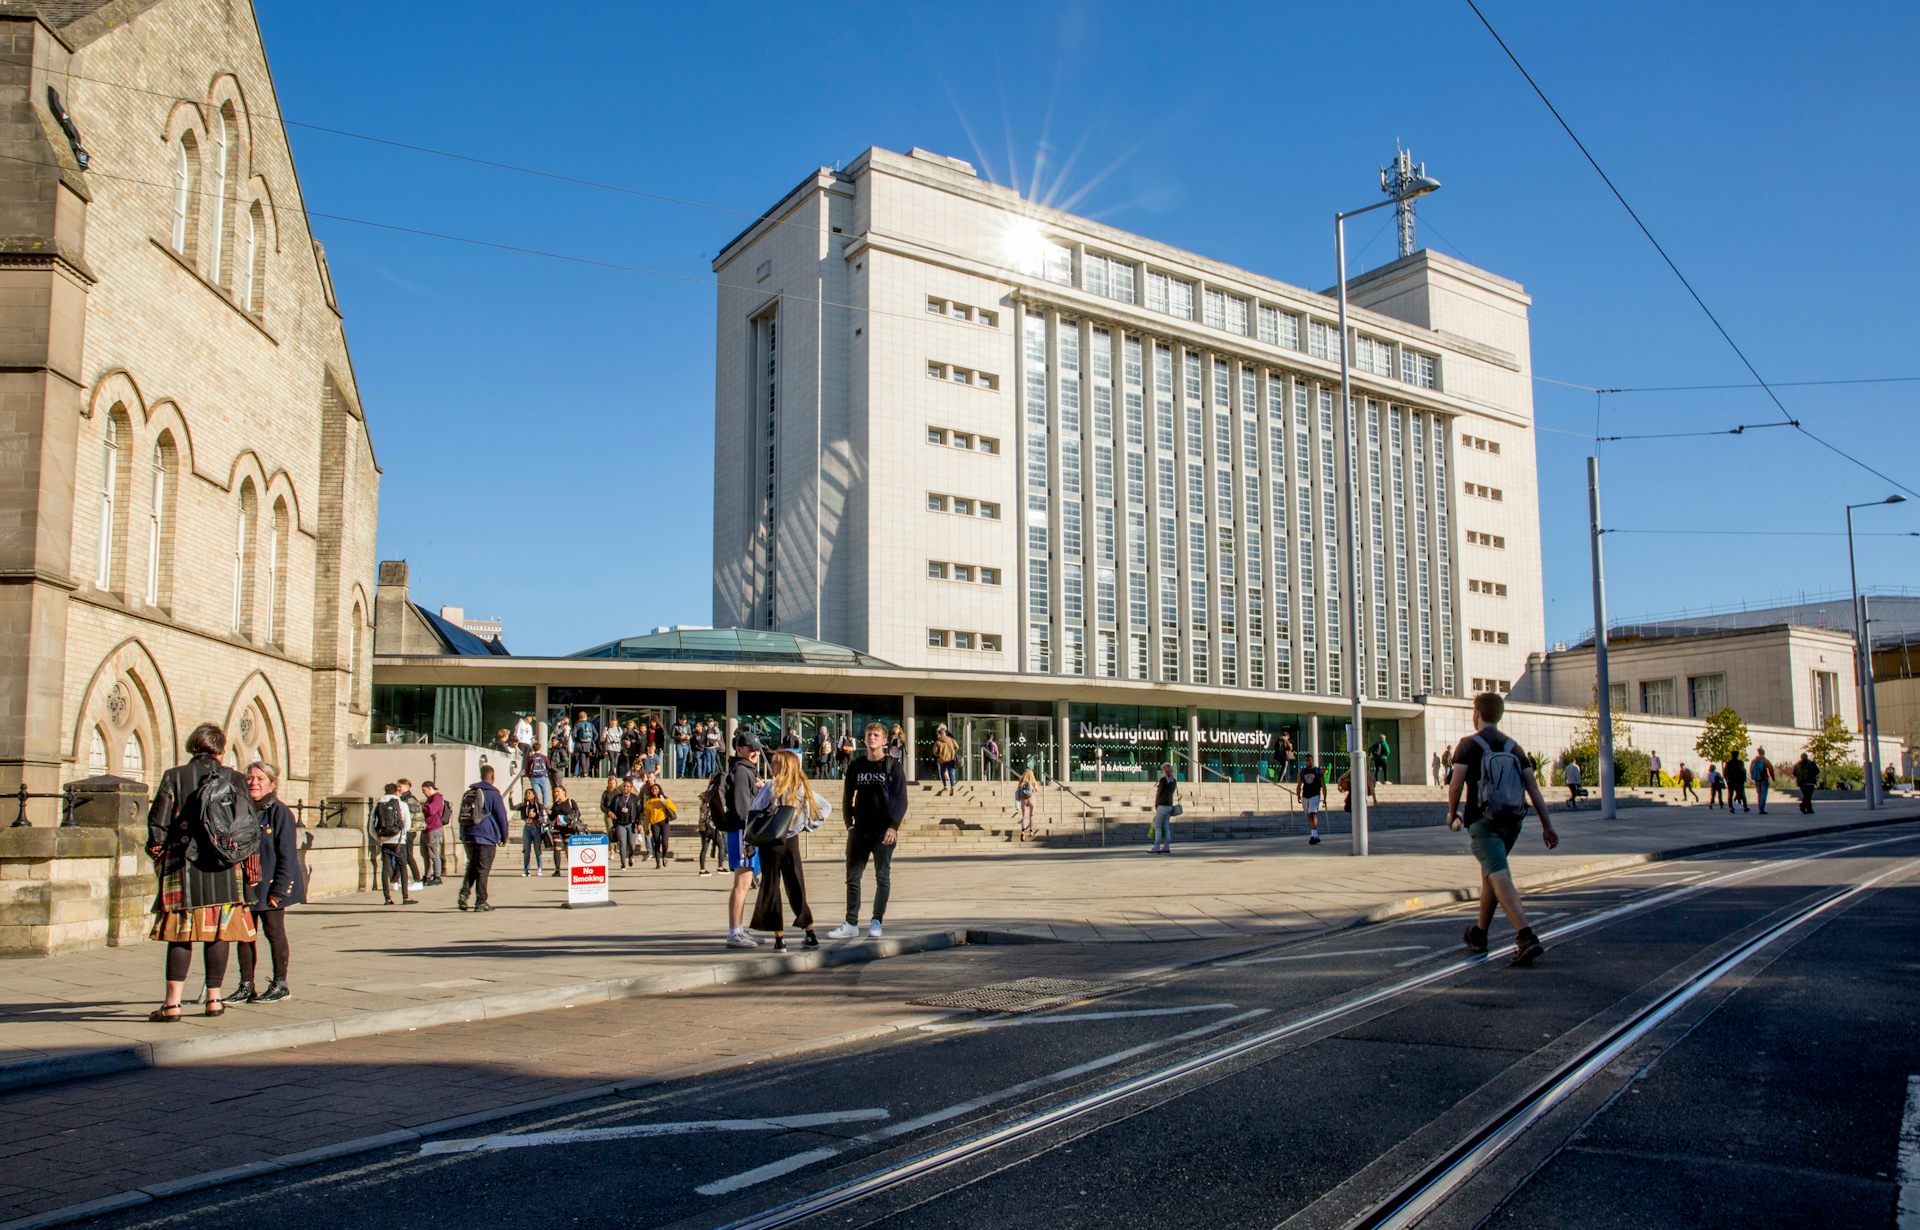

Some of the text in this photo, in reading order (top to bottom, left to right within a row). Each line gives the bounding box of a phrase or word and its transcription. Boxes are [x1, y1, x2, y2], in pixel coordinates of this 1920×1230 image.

[1080, 722, 1168, 744] Nottingham
[1210, 727, 1272, 749] University
[1106, 764, 1112, 772] &
[857, 772, 886, 782] BOSS
[583, 867, 594, 875] No
[573, 875, 604, 883] Smoking
